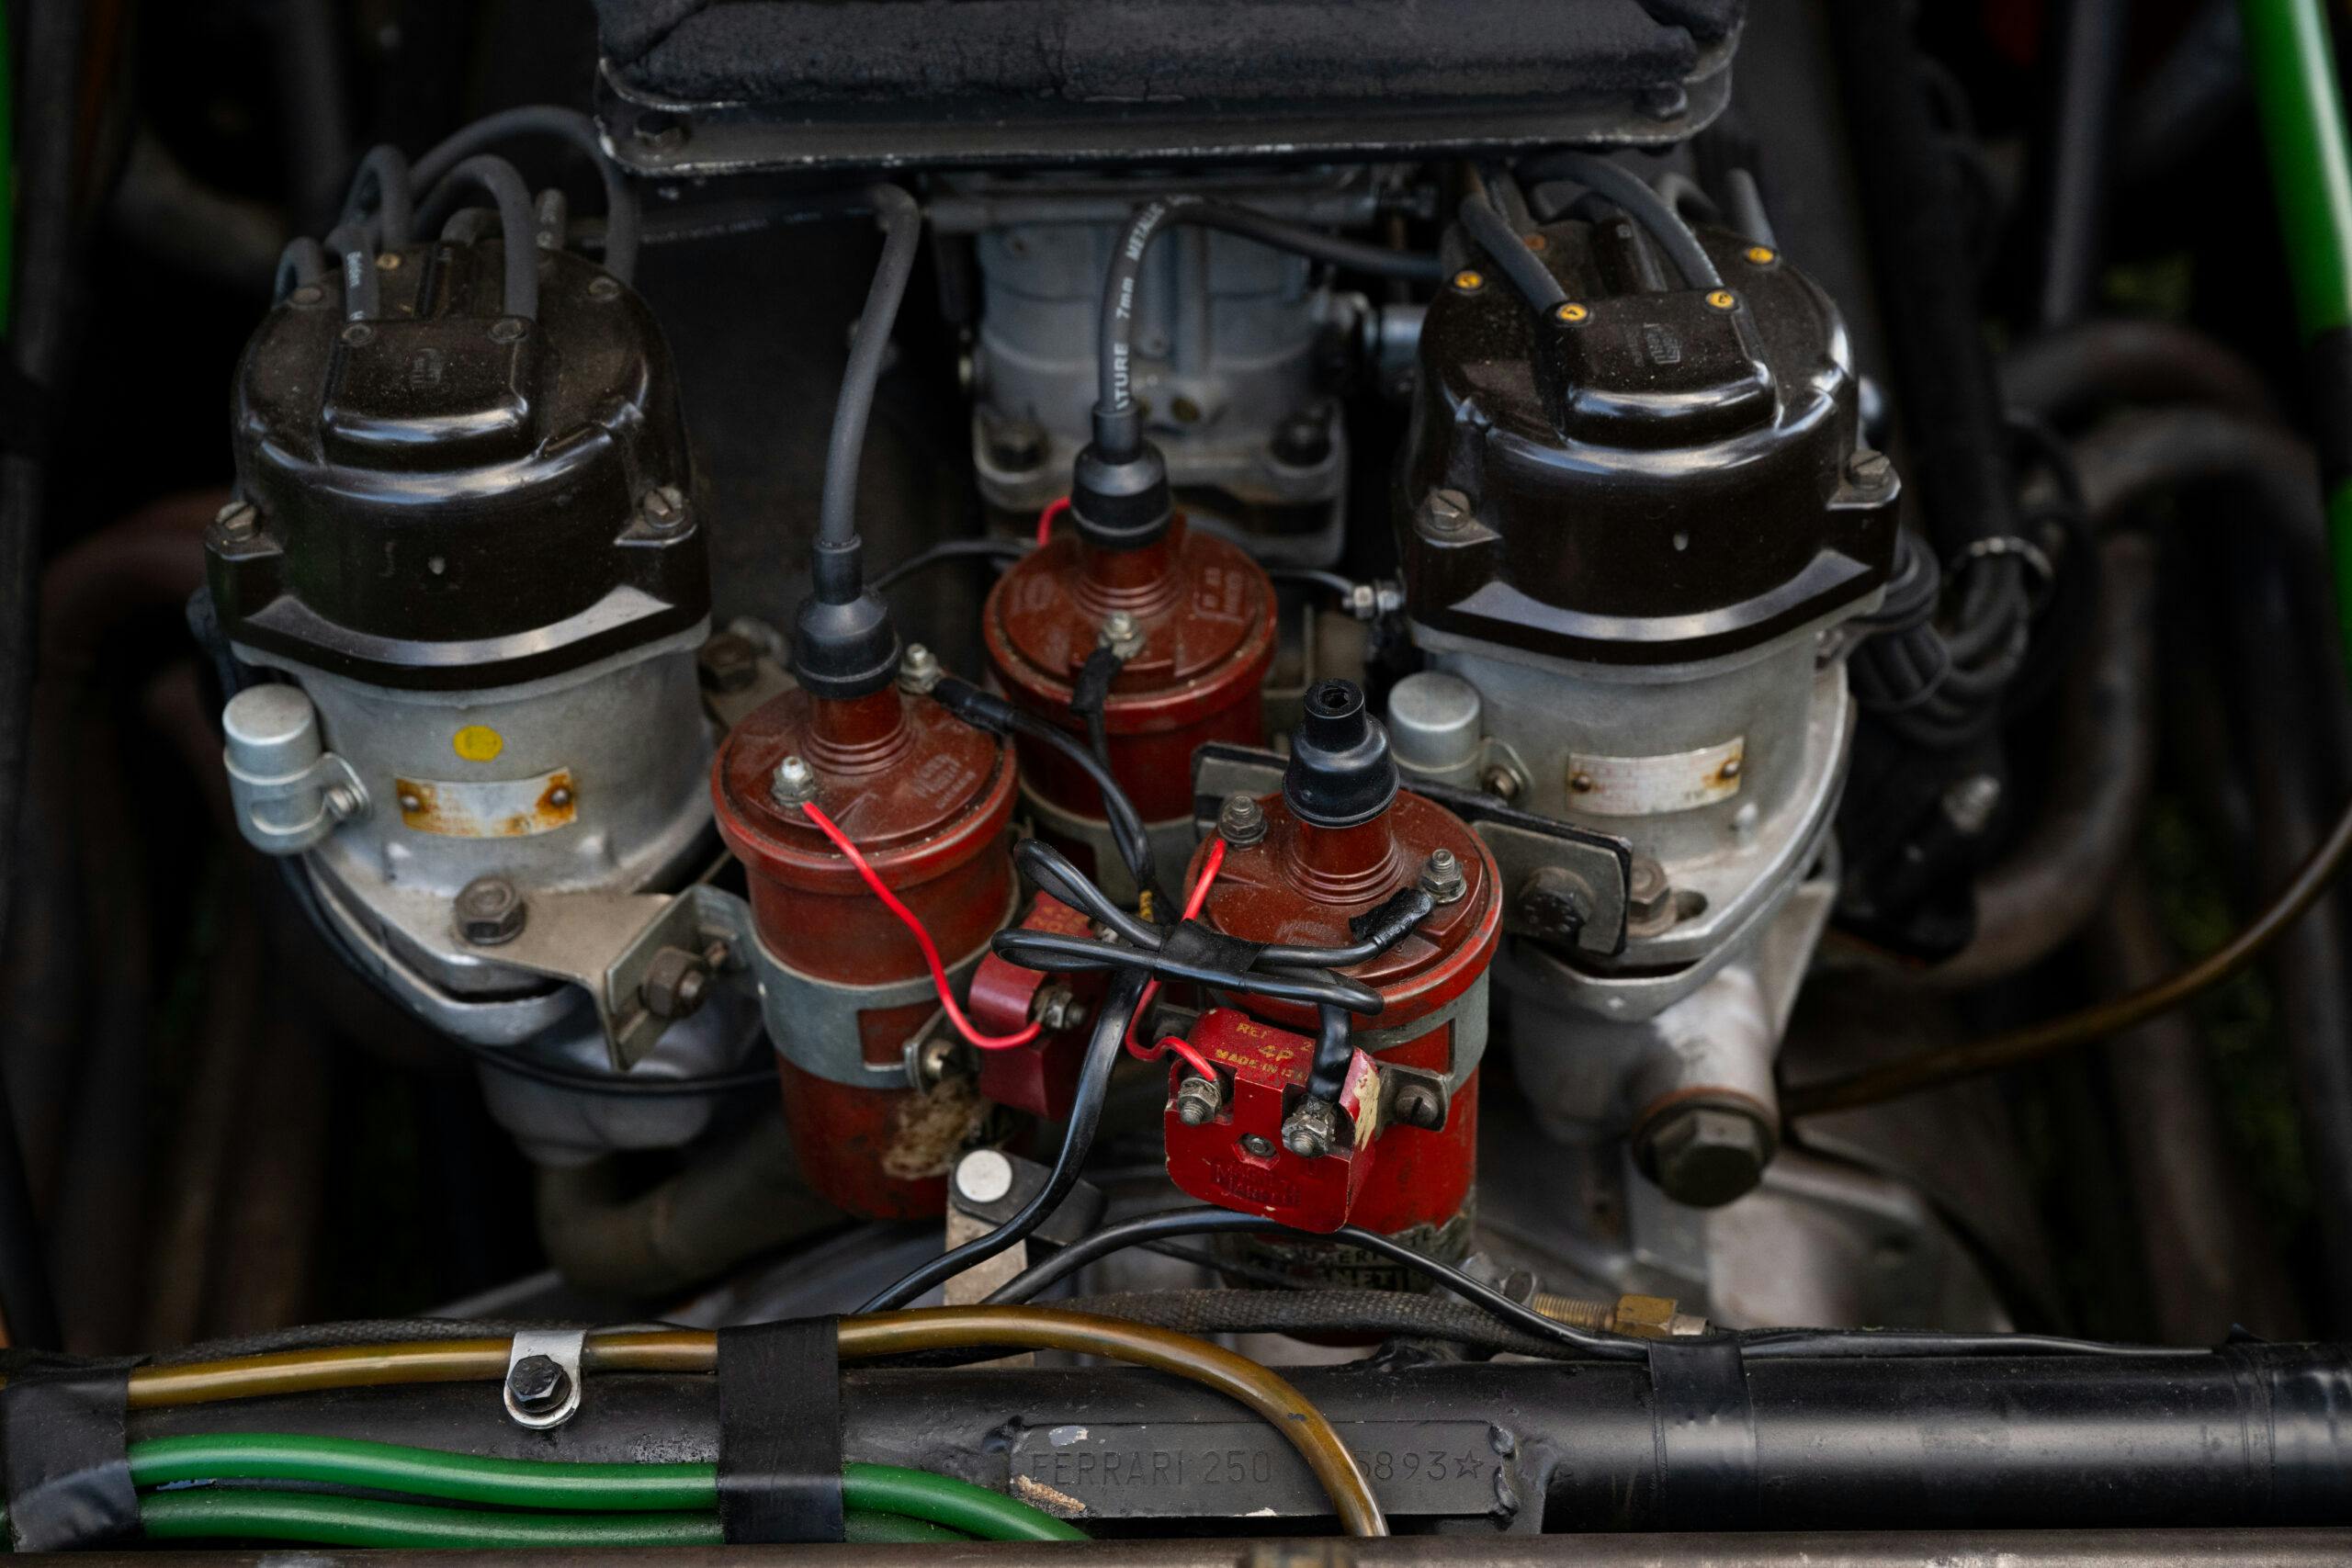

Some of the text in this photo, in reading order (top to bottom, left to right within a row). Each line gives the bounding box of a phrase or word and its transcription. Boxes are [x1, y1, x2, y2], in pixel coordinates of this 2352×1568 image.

[1115, 276, 1135, 320] 7mm
[1216, 1048, 1258, 1068] MADE
[1032, 1450, 1183, 1485] FERRARI
[1202, 1450, 1272, 1484] 250
